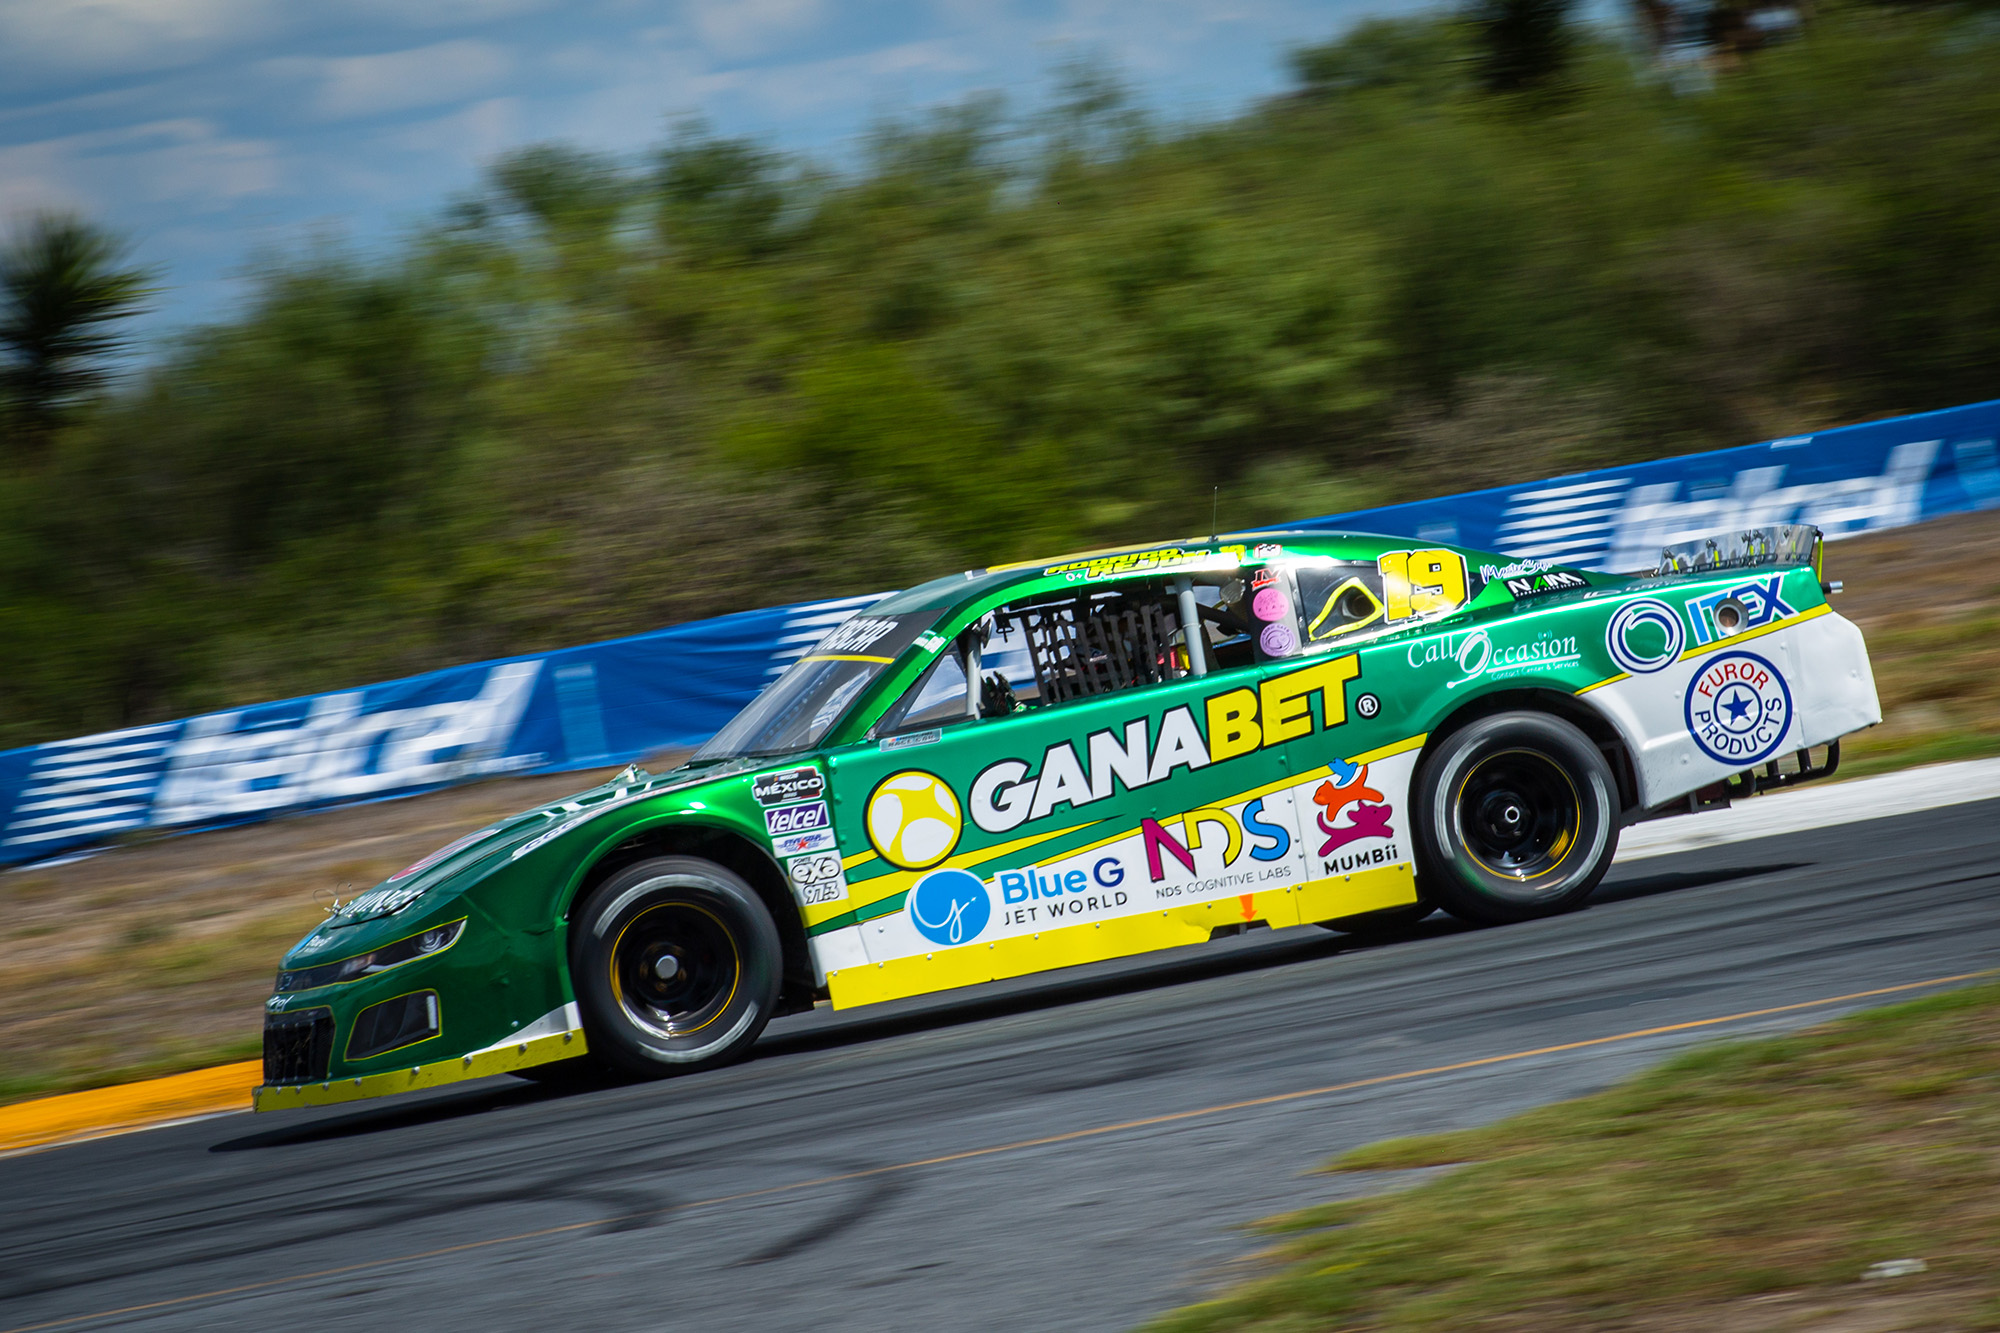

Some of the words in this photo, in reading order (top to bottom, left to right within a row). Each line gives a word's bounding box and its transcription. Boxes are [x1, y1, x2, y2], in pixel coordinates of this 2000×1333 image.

[1378, 549, 1469, 623] 19
[1507, 572, 1583, 594] NAIM
[1698, 662, 1769, 698] FUROR
[969, 653, 1361, 833] GANABET
[1695, 697, 1782, 755] PRODUCTS
[755, 777, 822, 797] MÉXICO
[769, 802, 823, 833] telcel
[1141, 798, 1290, 882] NDS
[791, 857, 840, 885] exa
[1000, 869, 1087, 905] Blue
[1093, 857, 1125, 888] G
[1156, 886, 1182, 899] NDS
[1187, 872, 1254, 893] COGNITIVE
[1259, 866, 1292, 881] LABS
[1005, 907, 1037, 926] JET
[1047, 891, 1128, 918] WORLD
